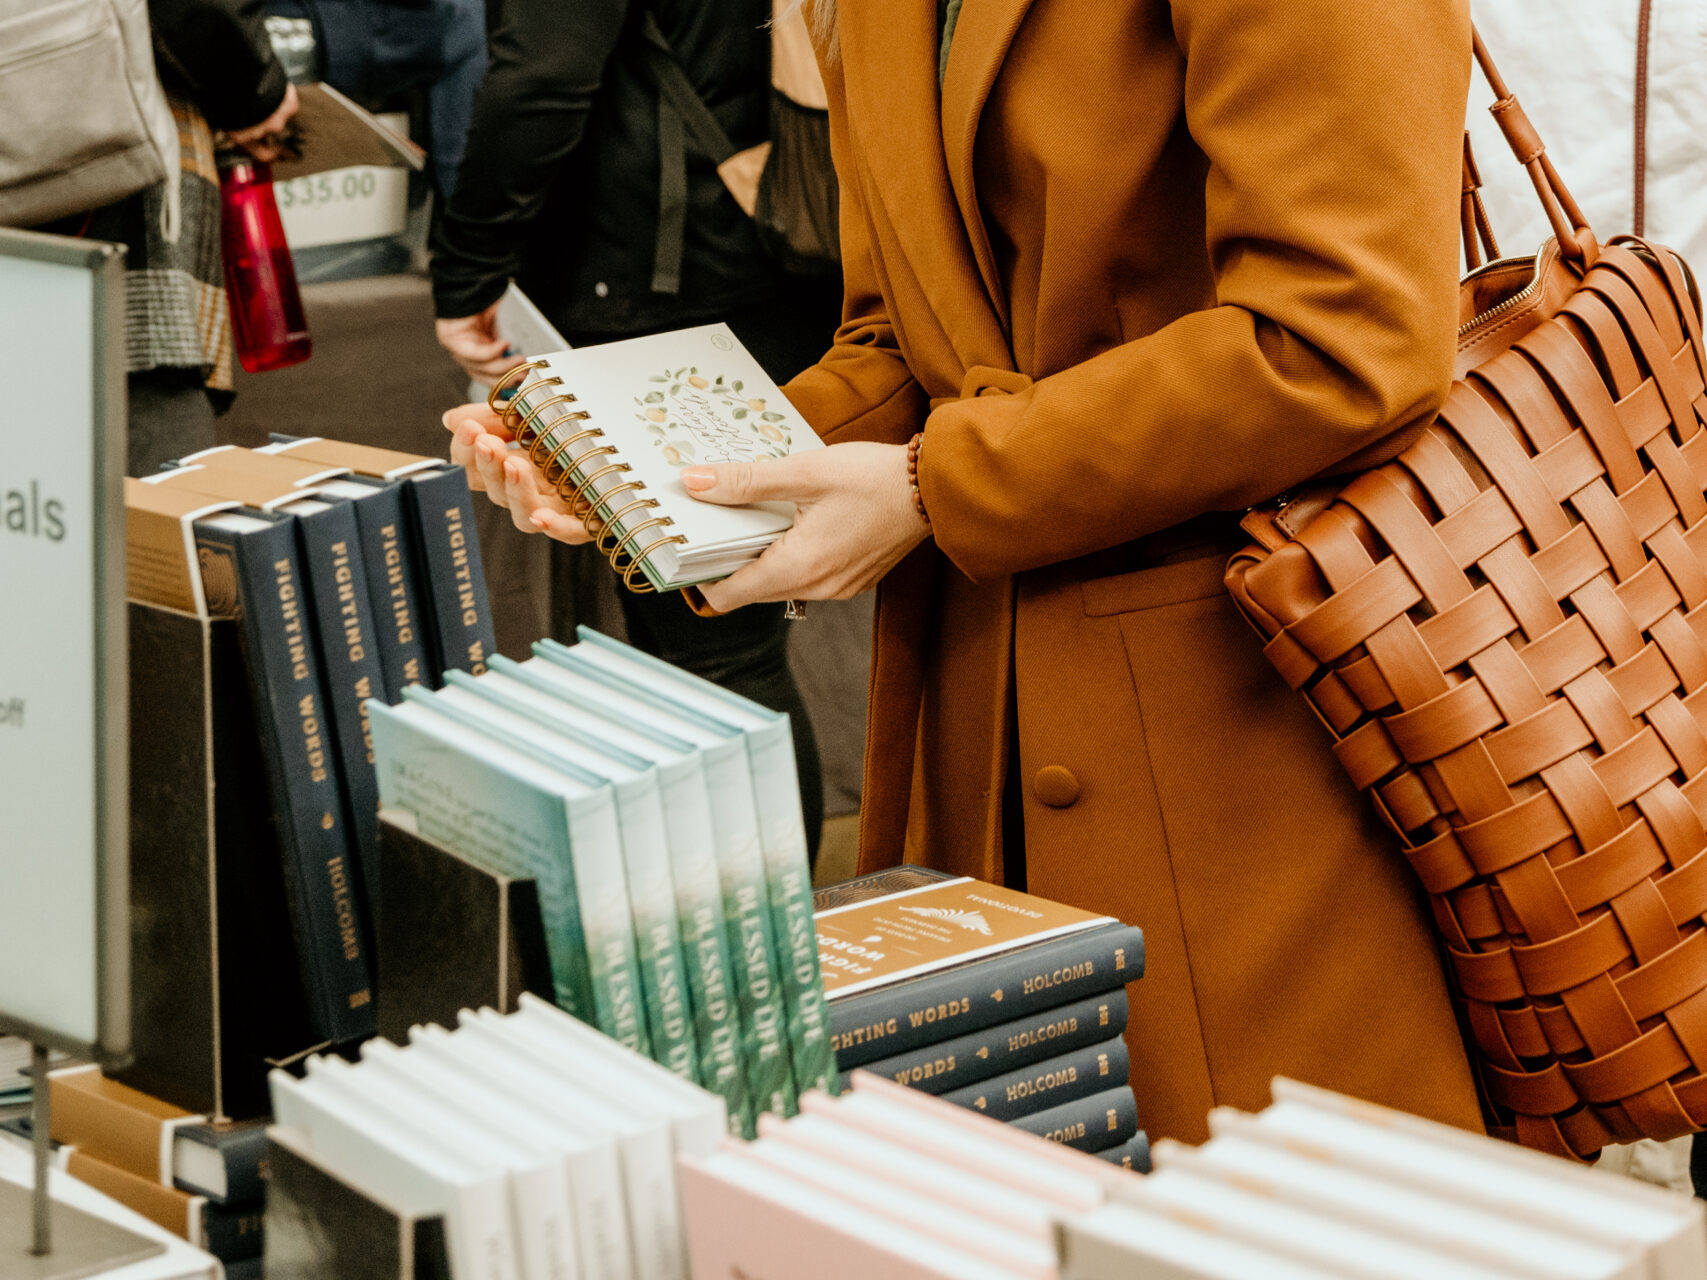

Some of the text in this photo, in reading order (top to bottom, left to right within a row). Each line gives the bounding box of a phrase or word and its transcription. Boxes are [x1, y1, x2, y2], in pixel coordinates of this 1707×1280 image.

[281, 171, 376, 208] $35.00
[0, 480, 66, 542] als
[380, 524, 413, 644] FIGHTING
[445, 507, 478, 626] FIGHTING
[331, 541, 365, 663] FIGHTING
[274, 558, 360, 961] FIGHTING WORDS HOLCOMB
[818, 953, 872, 974] FIGH
[830, 961, 1094, 1051] GHTING WORDS HOLCOMB
[895, 1017, 1078, 1085] WORDS HOLCOMB
[1006, 1067, 1078, 1101] HOLCOMB
[1044, 1122, 1086, 1144] COMB
